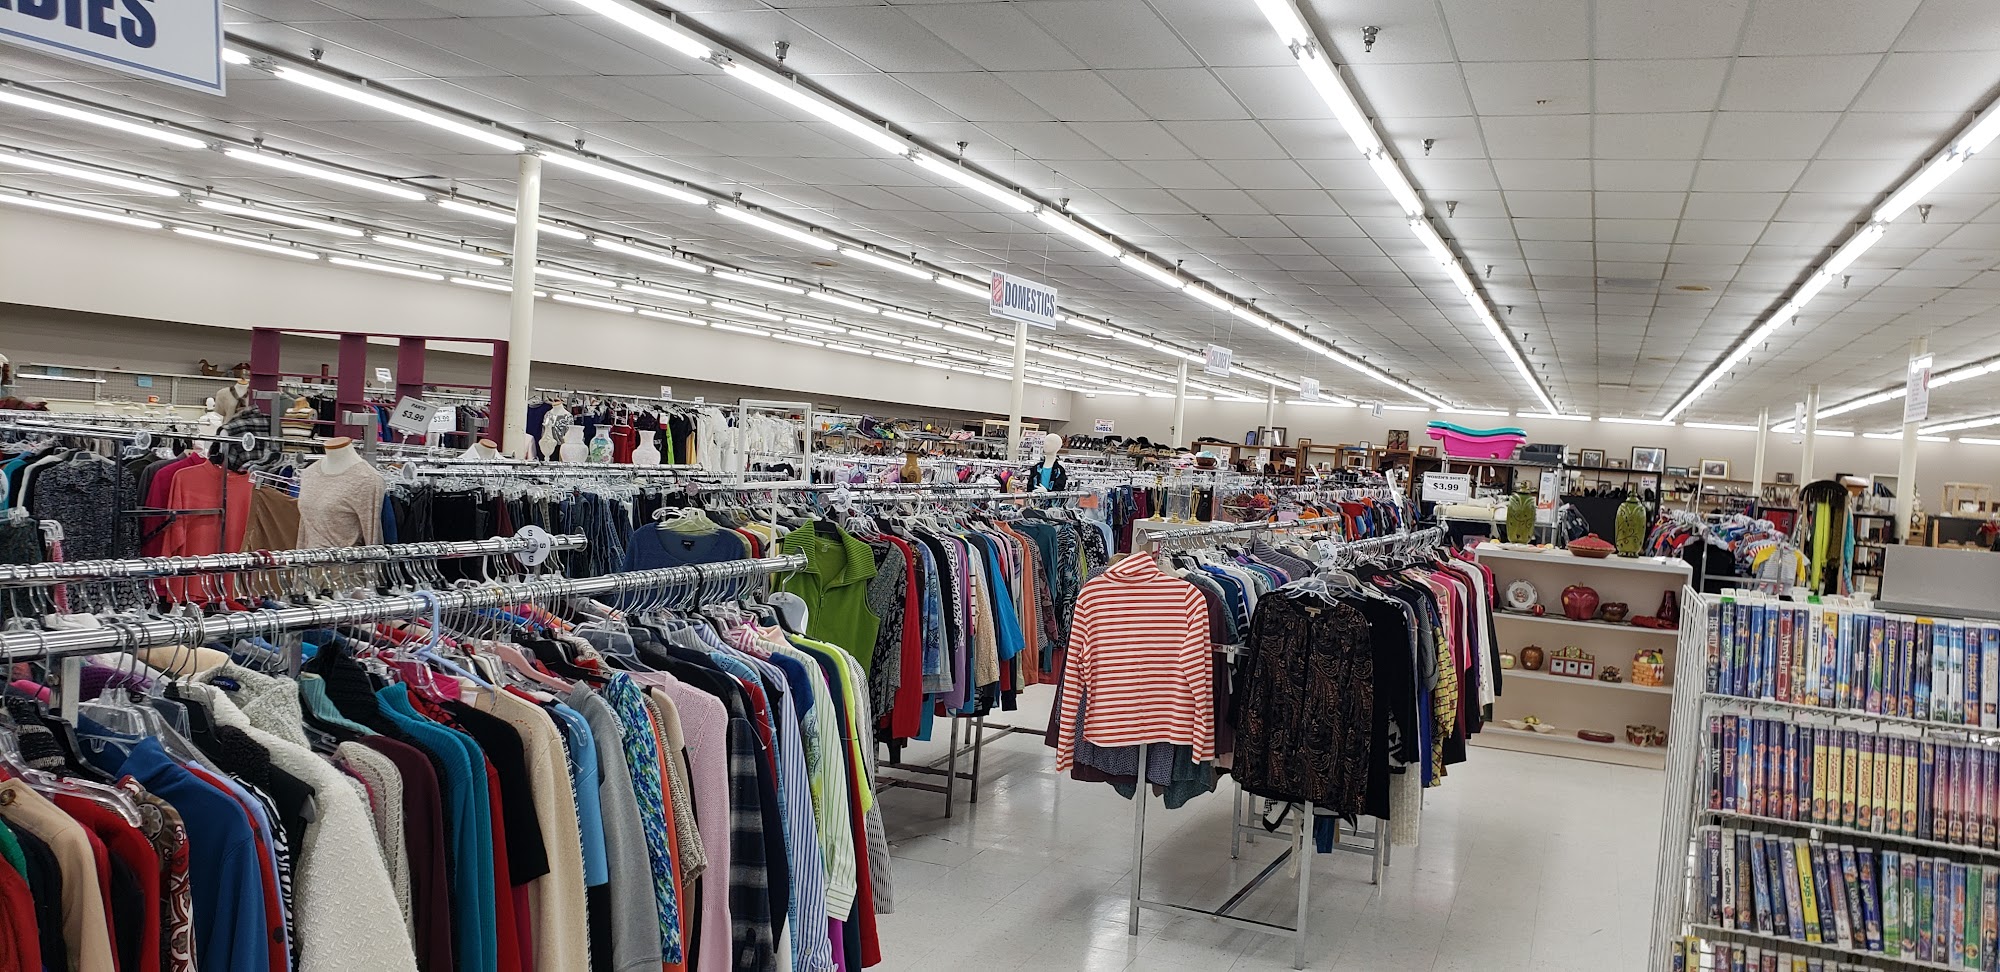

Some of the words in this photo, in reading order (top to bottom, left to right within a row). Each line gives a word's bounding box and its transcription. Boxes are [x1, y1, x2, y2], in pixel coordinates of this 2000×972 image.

[1004, 281, 1055, 318] DOMESTICS
[411, 403, 427, 411] PANTS
[402, 410, 425, 422] $3.99
[1433, 482, 1459, 491] $3.99
[1711, 849, 1719, 875] Sleeping
[1710, 875, 1719, 898] Beauty
